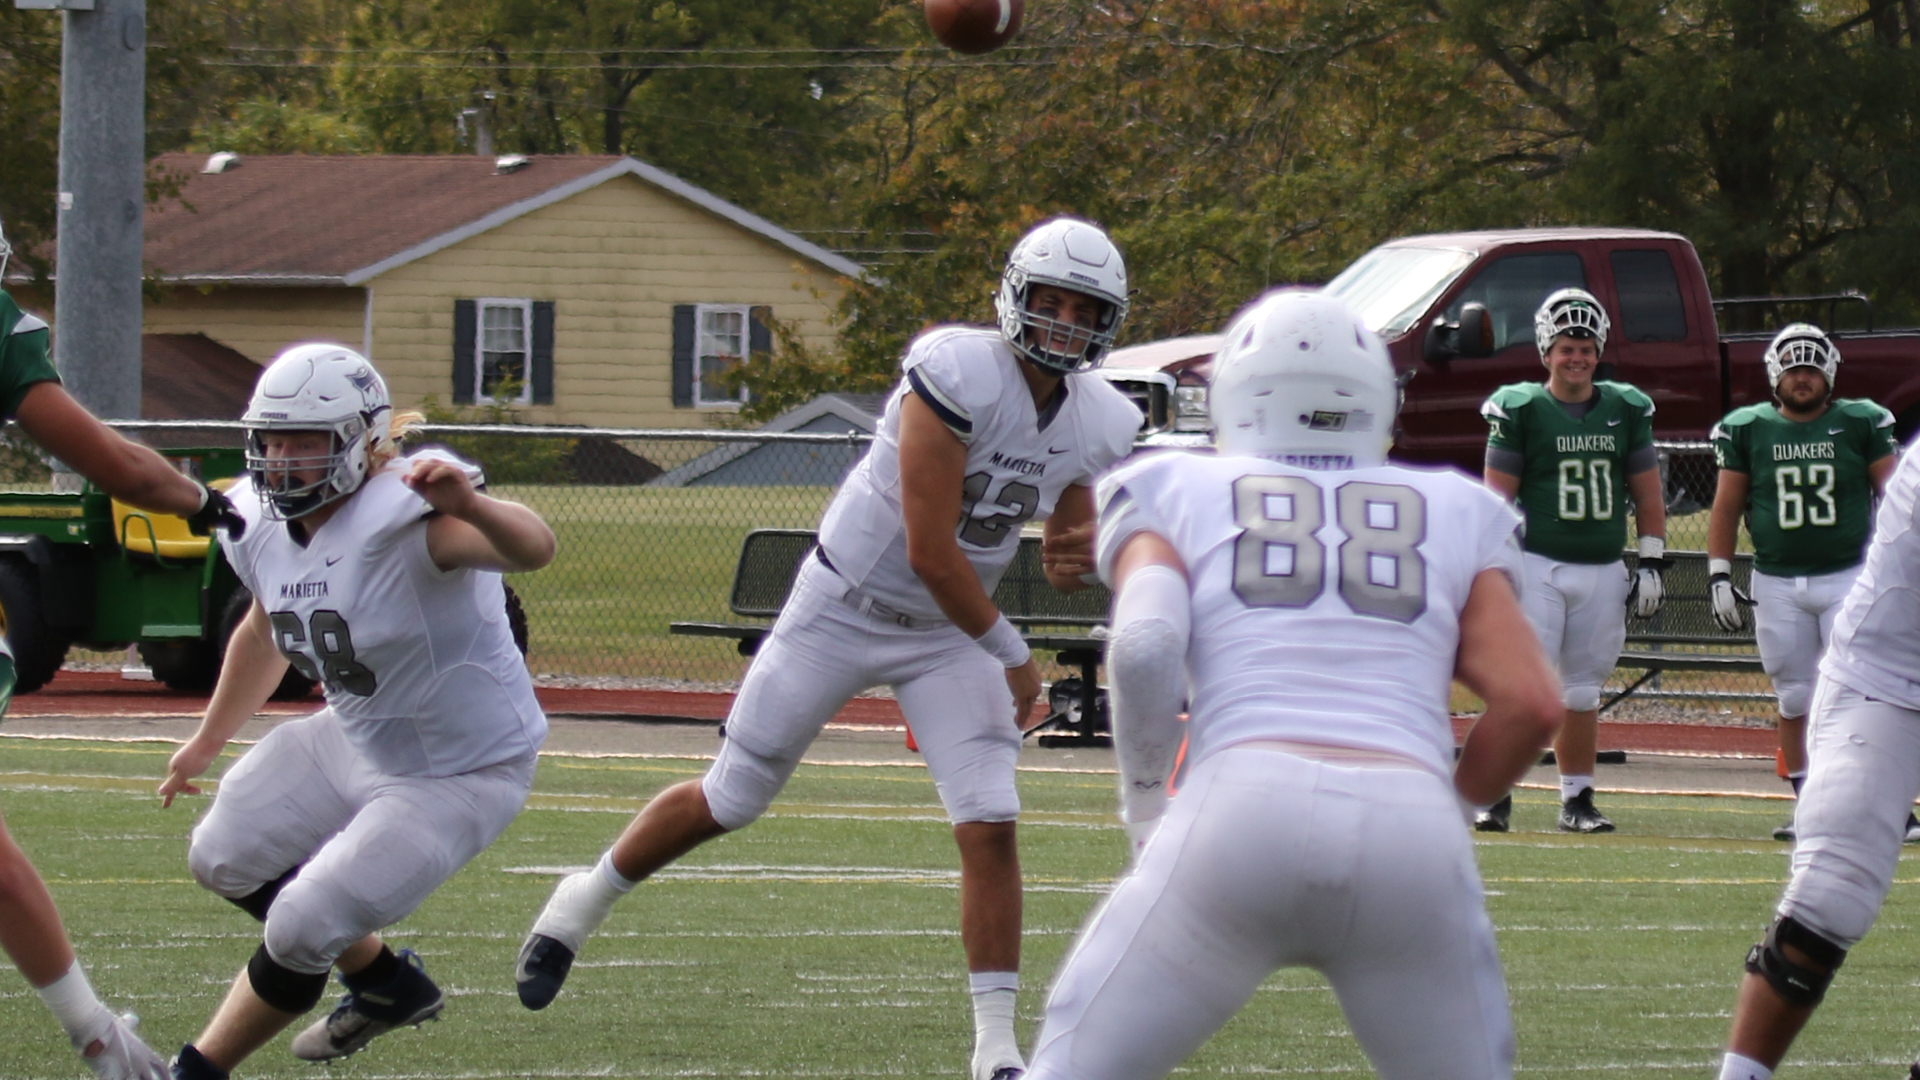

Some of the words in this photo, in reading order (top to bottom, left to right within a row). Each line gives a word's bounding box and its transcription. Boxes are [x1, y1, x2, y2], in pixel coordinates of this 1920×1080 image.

[989, 451, 1046, 477] MARIETTA
[1557, 435, 1615, 452] QUAKERS
[1773, 442, 1835, 460] QUAKERS
[1559, 459, 1613, 520] 60
[1776, 464, 1837, 529] 63
[1232, 474, 1428, 625] 88
[280, 581, 329, 599] MARIETTA
[269, 609, 377, 697] 68
